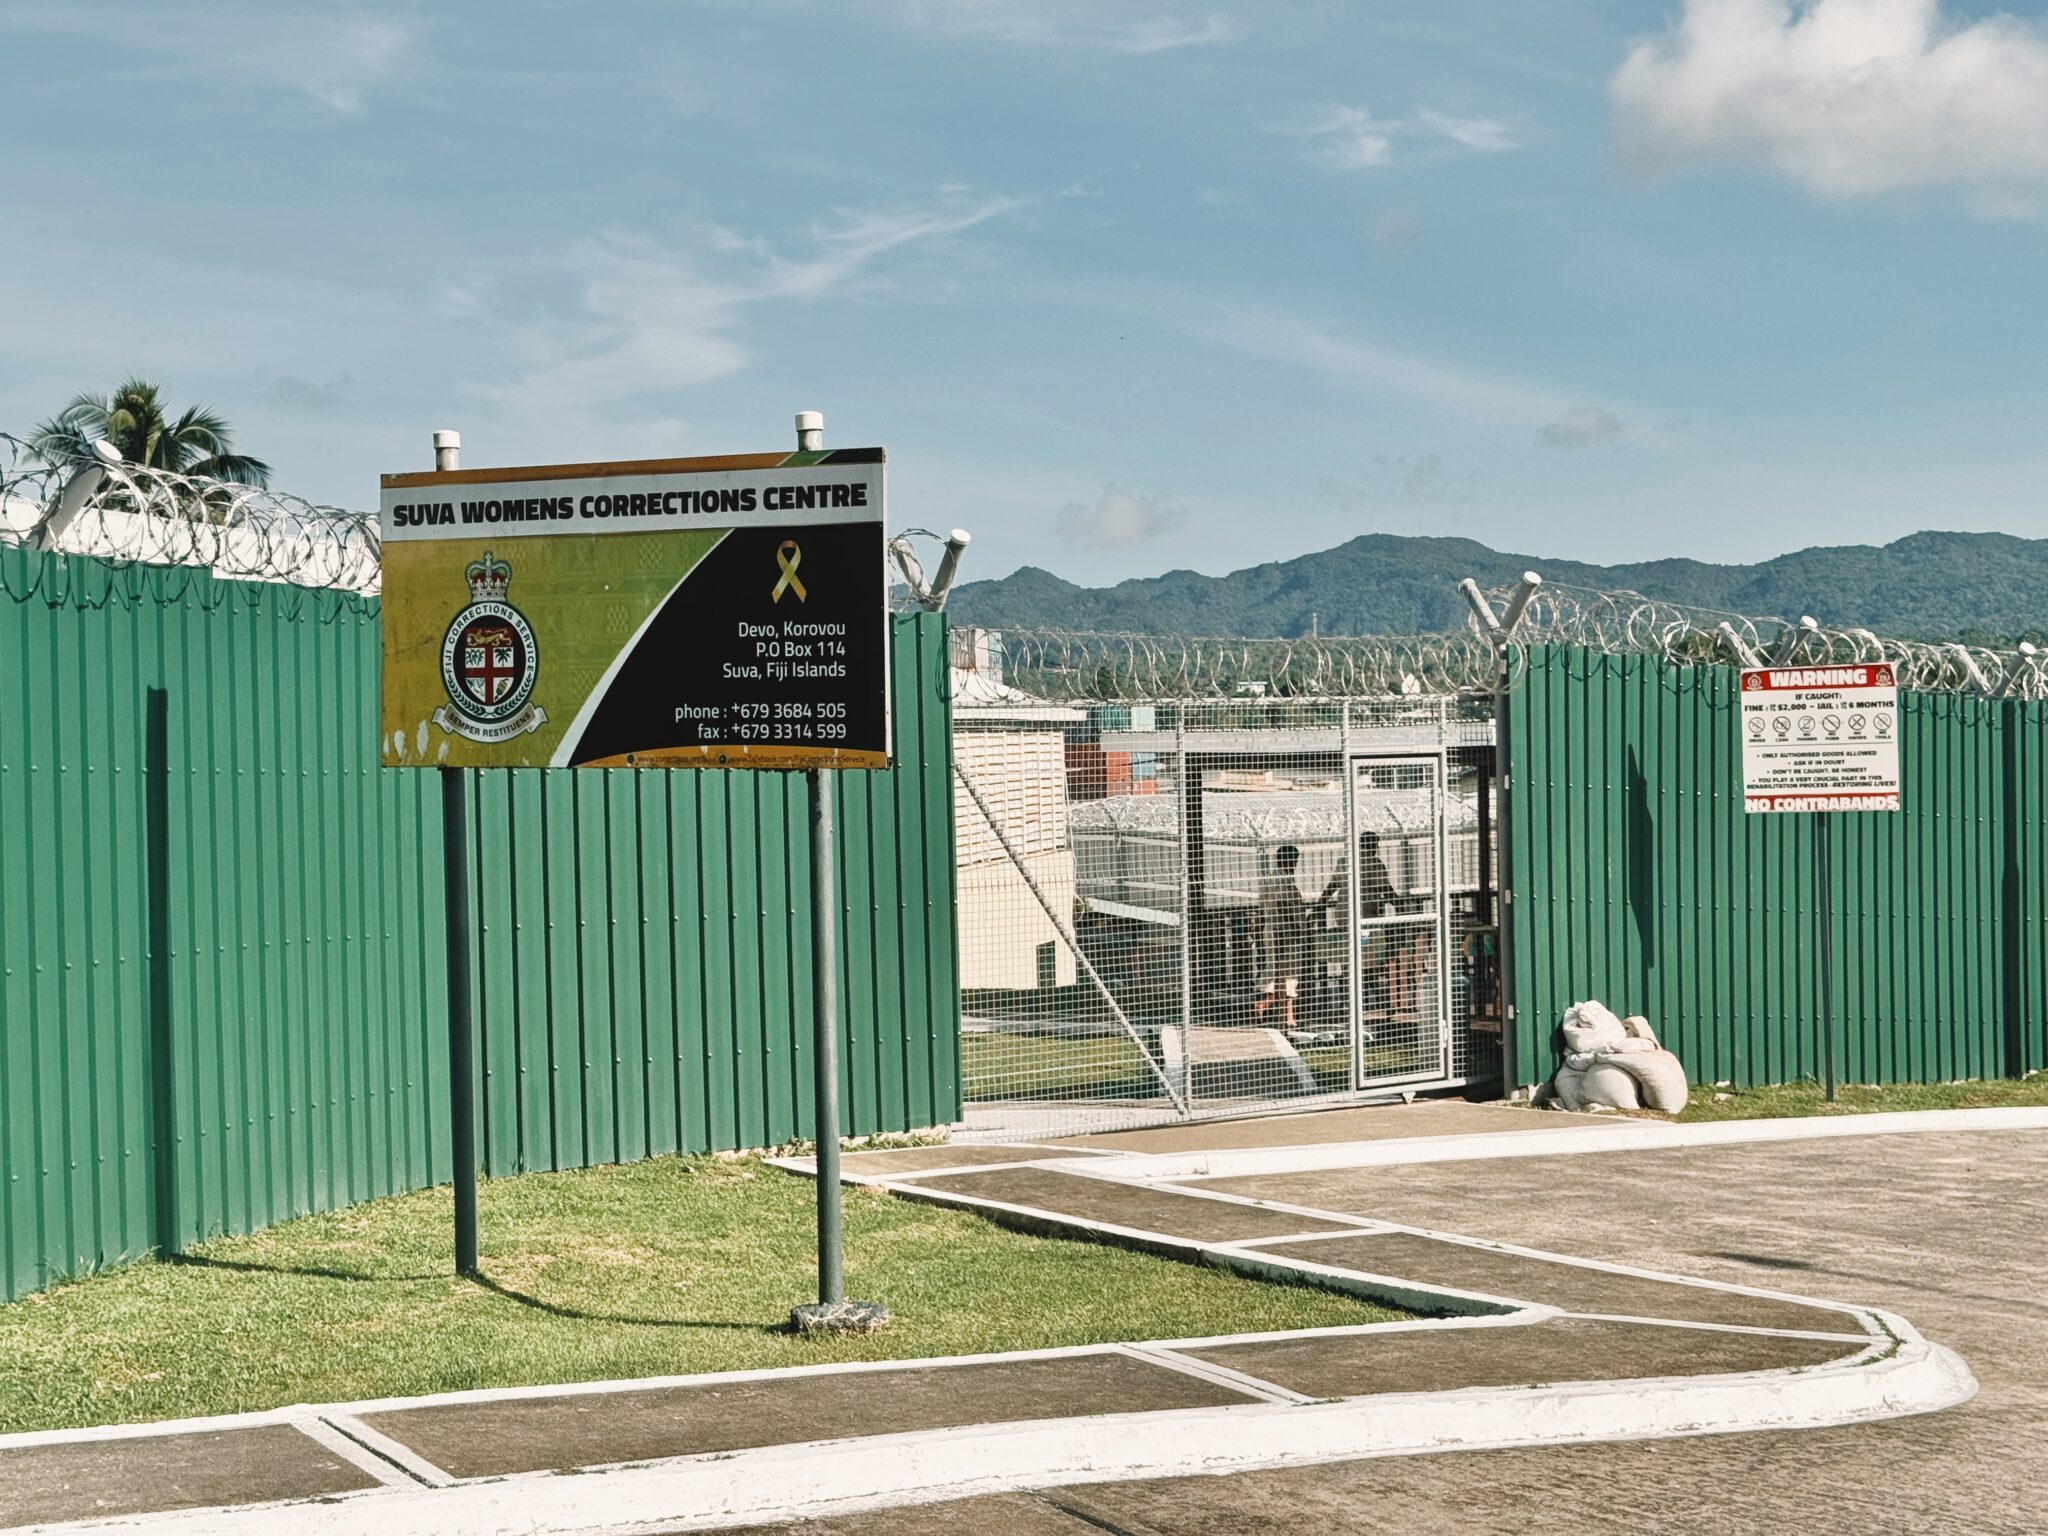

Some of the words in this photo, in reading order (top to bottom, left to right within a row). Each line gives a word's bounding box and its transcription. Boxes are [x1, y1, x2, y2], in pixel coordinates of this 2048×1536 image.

[393, 502, 456, 527] SUVA
[461, 497, 574, 523] WOMENS
[579, 488, 757, 518] CORRECTIONS
[763, 483, 867, 511] CENTRE
[448, 604, 514, 644] CORRECTIONS
[515, 620, 534, 672] SERVICE
[738, 622, 779, 639] Devo,
[784, 620, 846, 636] Korovou
[756, 642, 780, 657] P.O
[784, 642, 812, 657] Box
[817, 640, 846, 656] 114
[722, 662, 762, 680] Suva,
[766, 662, 788, 682] Fiji
[792, 660, 846, 678] Islands
[1769, 668, 1868, 688] WARNING
[675, 703, 720, 723] phone
[732, 702, 770, 718] +679
[774, 704, 812, 718] 3684
[816, 703, 846, 718] 505
[448, 712, 480, 736] SEMPER
[482, 712, 532, 737] RESTITUENS
[698, 723, 720, 739] fax
[732, 723, 770, 739] +679
[774, 724, 812, 739] 3314
[816, 723, 846, 739] 599
[1746, 798, 1771, 812] NO
[1774, 795, 1899, 812] CONTRABANDS
